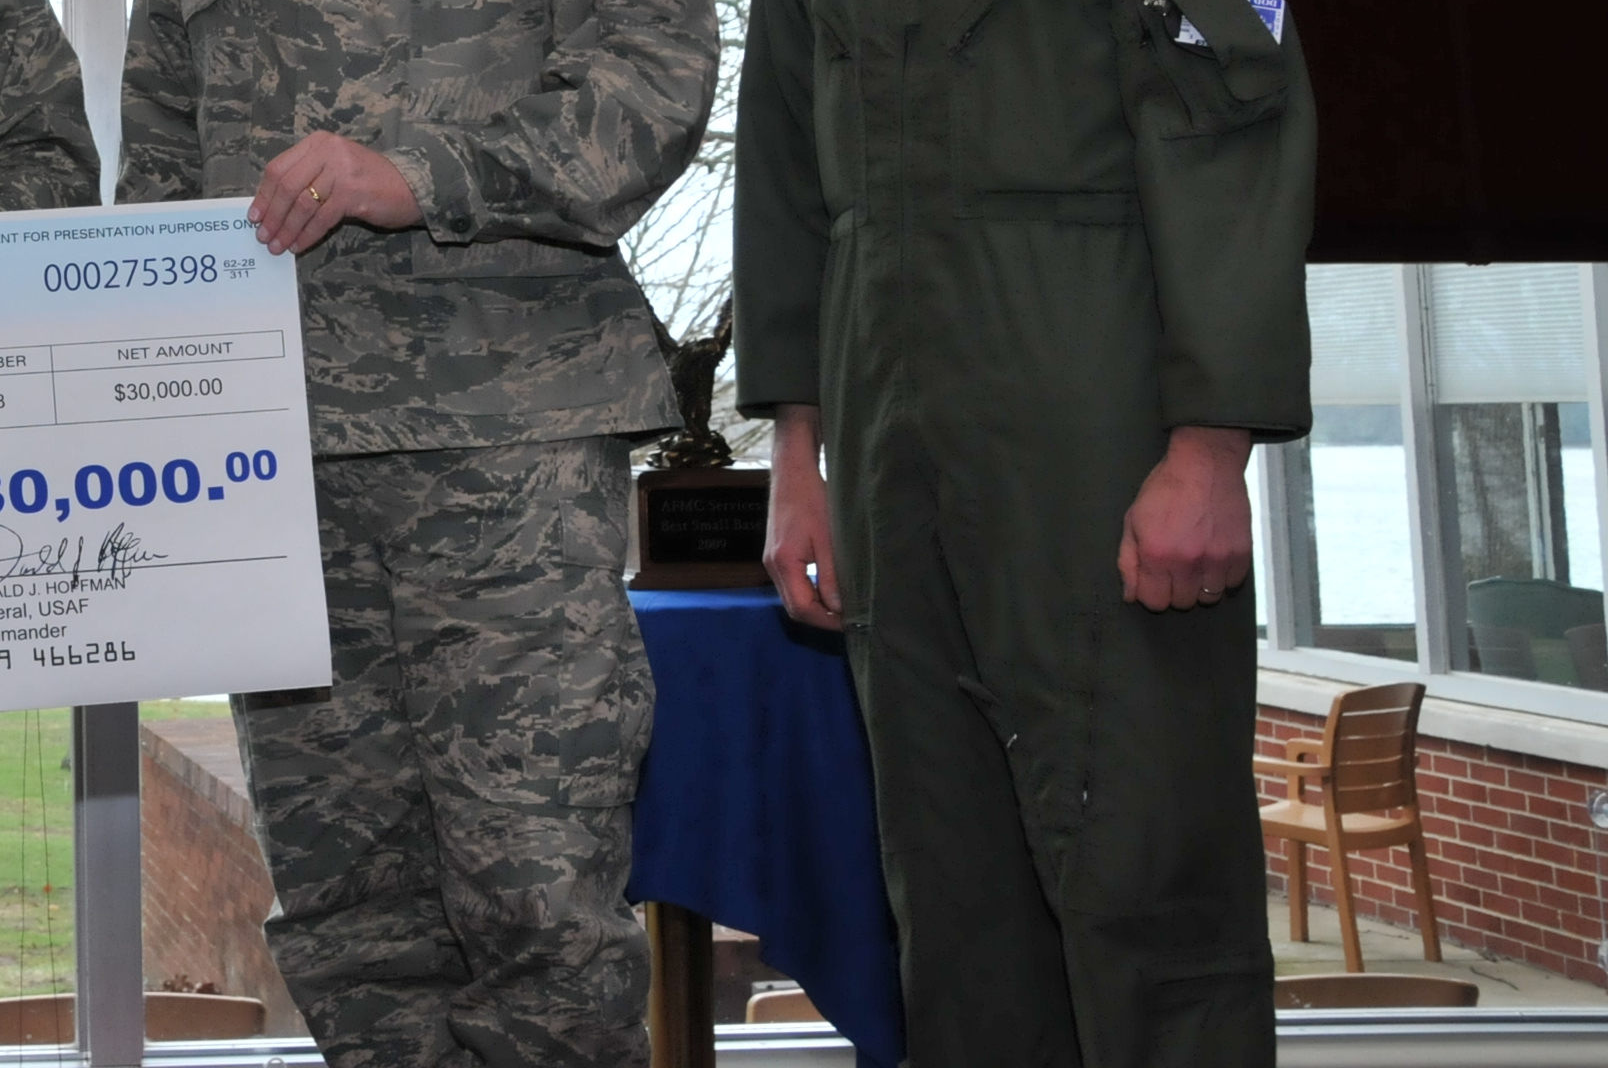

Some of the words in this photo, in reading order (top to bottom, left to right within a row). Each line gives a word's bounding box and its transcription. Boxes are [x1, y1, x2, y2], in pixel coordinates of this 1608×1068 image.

[24, 231, 49, 242] FOR
[54, 225, 154, 240] PRESENTATION
[159, 220, 229, 234] PURPOSES
[223, 258, 256, 268] 62-28
[44, 255, 217, 292] 000275398
[229, 270, 250, 279] 311
[118, 347, 150, 360] NET
[156, 342, 232, 357] AMOUNT
[115, 378, 222, 402] $30,000.00
[29, 583, 42, 597] J.
[46, 577, 126, 595] HOFFMAN
[39, 598, 88, 616] USAF
[34, 641, 135, 667] 466286
